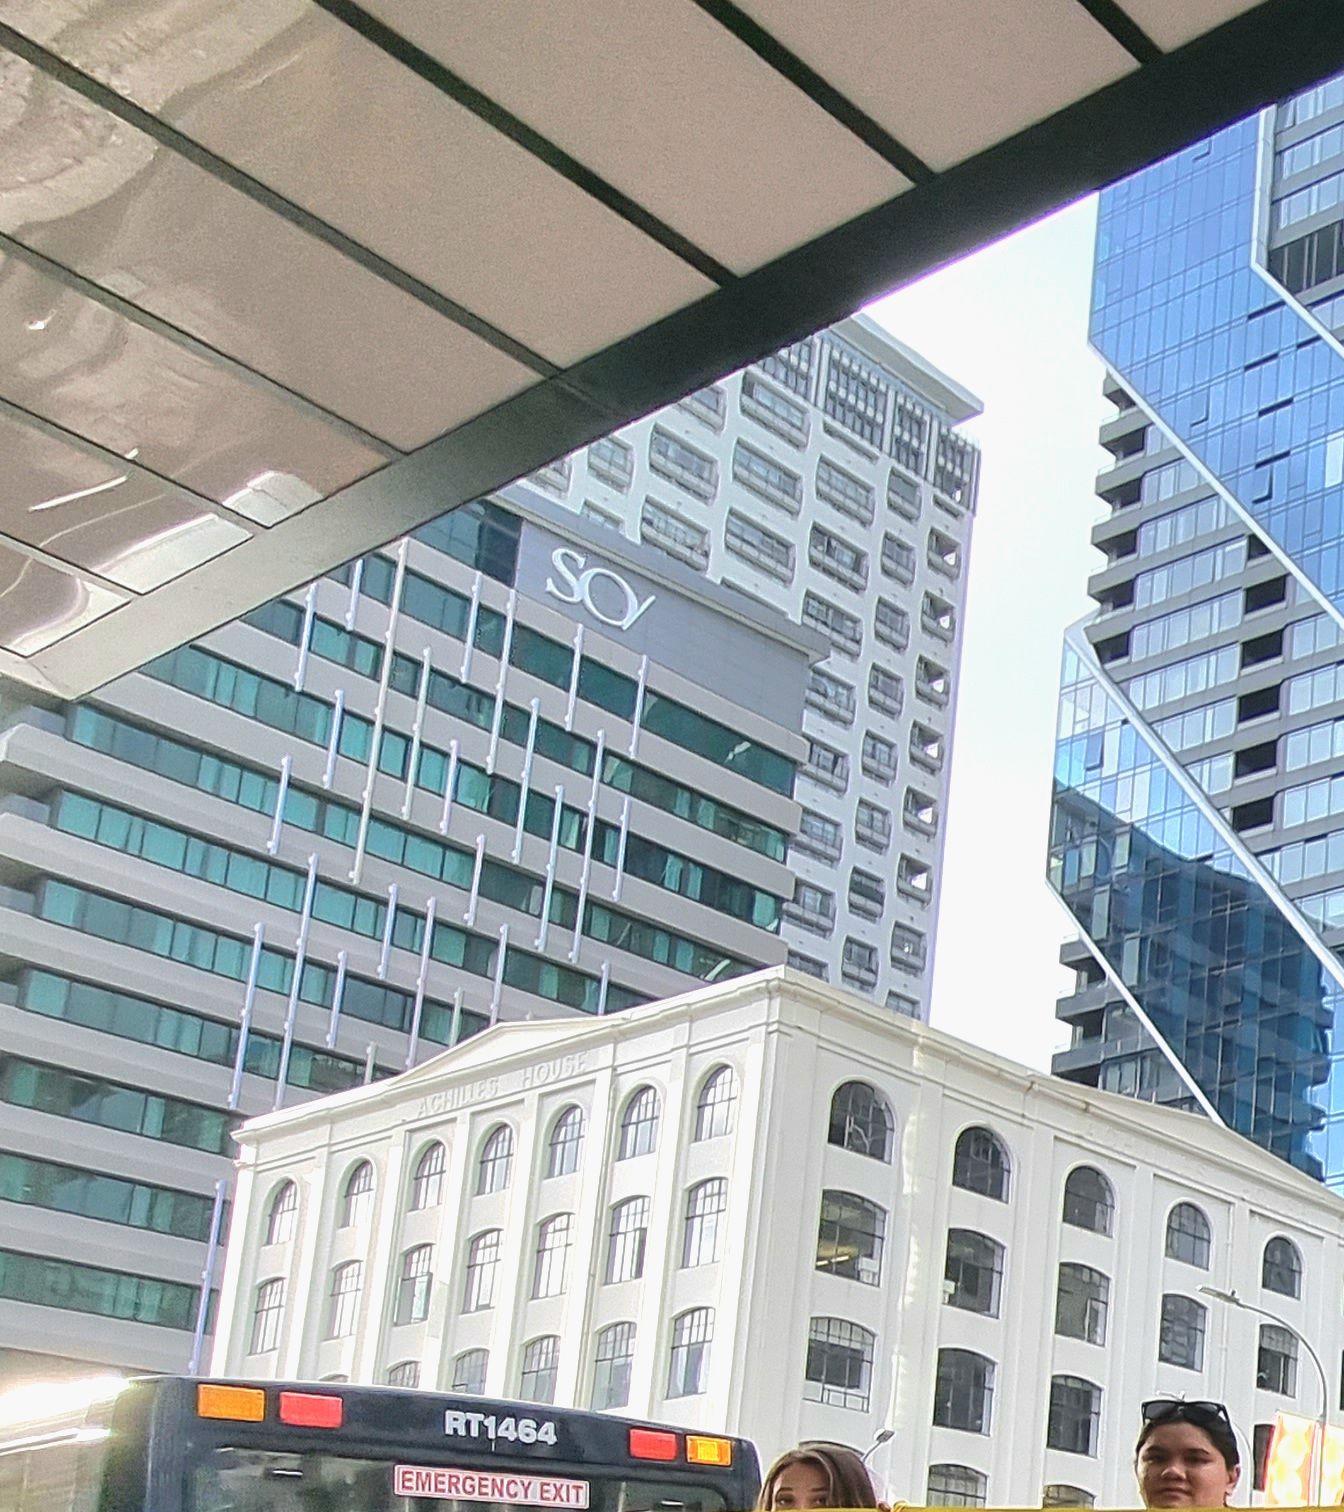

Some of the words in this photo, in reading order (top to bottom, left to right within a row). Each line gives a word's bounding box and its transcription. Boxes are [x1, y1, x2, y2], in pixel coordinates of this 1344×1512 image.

[417, 1076, 499, 1118] ACHILLES
[522, 1052, 587, 1090] HOUSE
[445, 1409, 558, 1446] RT1464
[401, 1470, 532, 1500] EMERGENCY
[539, 1481, 584, 1504] EXIT
